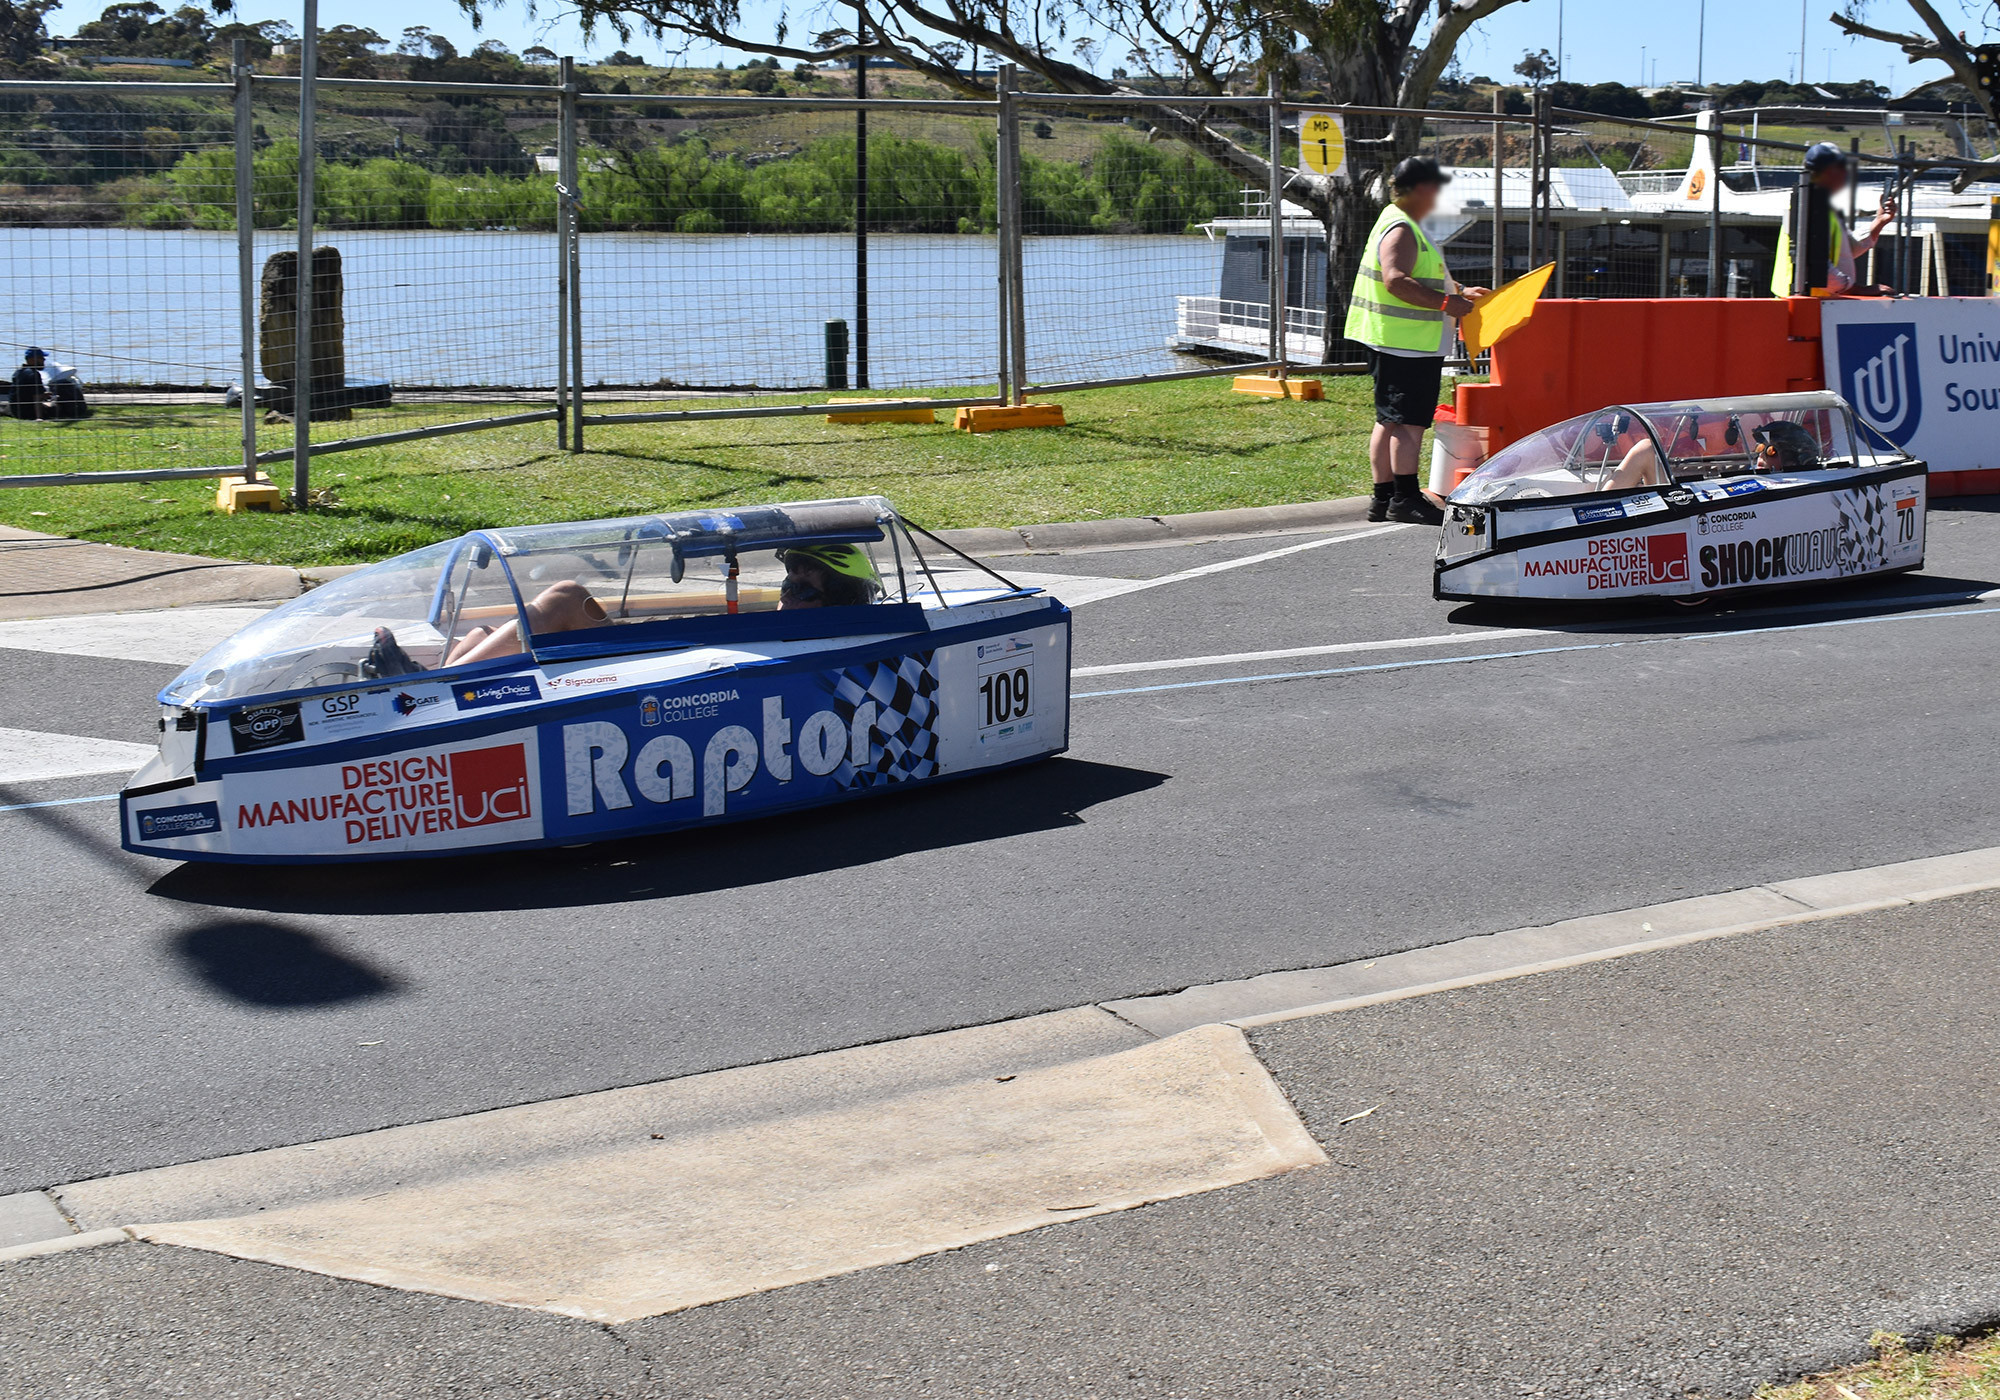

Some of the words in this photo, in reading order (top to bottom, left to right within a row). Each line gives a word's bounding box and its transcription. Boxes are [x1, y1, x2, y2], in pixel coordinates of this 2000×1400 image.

[1313, 121, 1329, 131] MP
[1318, 138, 1328, 165] 1
[1453, 168, 1541, 179] GALAX
[1939, 332, 2000, 364] Univ
[1945, 382, 2000, 412] Sou
[1711, 511, 1757, 524] CONCORDIA
[1711, 521, 1744, 533] COLLEGE
[1897, 507, 1914, 543] 70
[1588, 536, 1647, 555] DESIGN
[1524, 553, 1647, 577] MANUFACTURE
[1587, 570, 1648, 590] DELIVER
[565, 675, 618, 687] Signarama
[322, 694, 359, 713] GSP
[663, 689, 740, 711] CONCORDIA
[980, 668, 1029, 725] 109
[247, 708, 283, 721] QUALITY
[663, 705, 719, 723] COLLEGE
[253, 718, 279, 731] QPP
[563, 695, 877, 817] Raptor
[342, 754, 448, 790] DESIGN
[237, 781, 451, 829] MANUFACTURE
[155, 812, 205, 824] CONCORDIA
[345, 808, 455, 844] DELIVER
